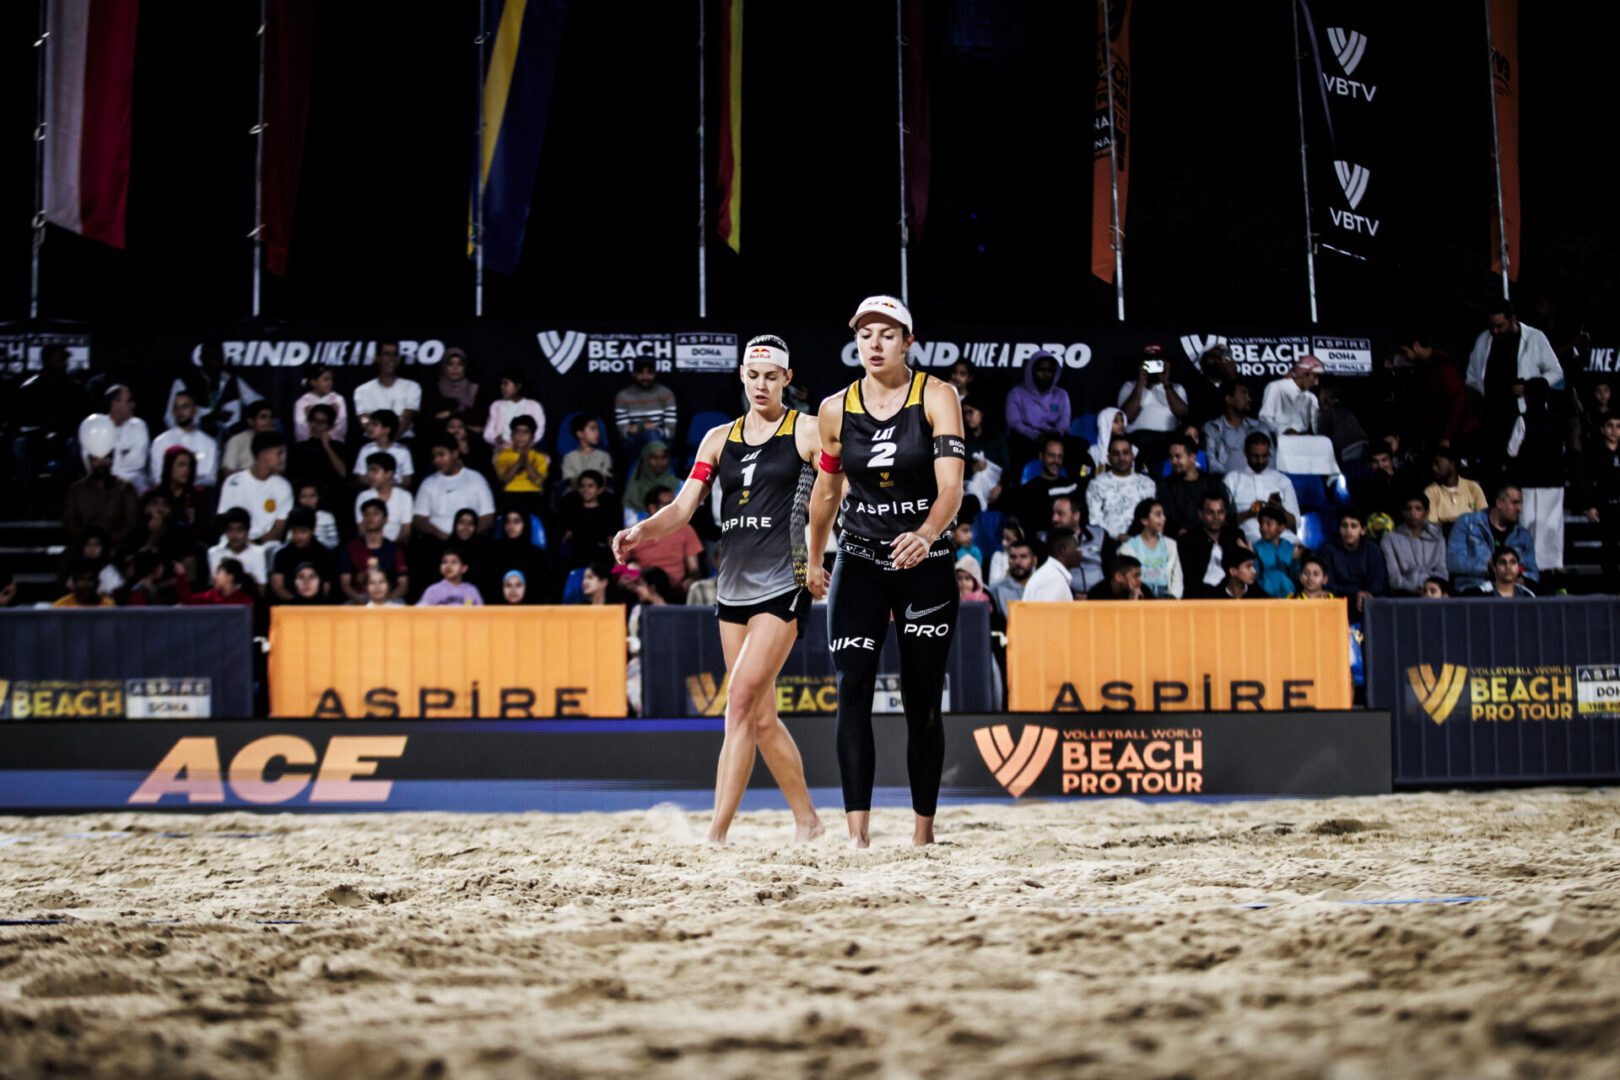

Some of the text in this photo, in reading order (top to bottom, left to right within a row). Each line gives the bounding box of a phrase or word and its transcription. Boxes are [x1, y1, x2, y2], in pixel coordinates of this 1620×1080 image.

[1322, 72, 1377, 102] VBTV
[1329, 206, 1380, 237] VBTV
[588, 341, 673, 359] BEACH
[680, 335, 734, 344] ASPIRE
[1317, 339, 1367, 349] ASPIRE
[192, 340, 310, 366] RIND
[311, 341, 350, 365] LIKE
[841, 341, 960, 367] GND
[963, 343, 999, 367] LIKE
[997, 343, 1010, 367] A
[1229, 344, 1310, 362] BEACH
[1583, 348, 1614, 372] IKE
[588, 360, 673, 373] PRO TR
[871, 425, 896, 441] LAT
[866, 441, 898, 468] 2
[741, 462, 758, 487] 1
[856, 498, 930, 516] ASPIRE
[721, 515, 773, 534] ASPIRE
[903, 623, 950, 638] PRO
[1580, 669, 1620, 681] ASP
[776, 685, 839, 712] EAC
[1470, 676, 1573, 702] BEACH
[12, 690, 122, 718] BEACH
[1472, 703, 1573, 720] PRO TOUR
[1062, 729, 1203, 740] VOLLEYBALL WORLD
[1062, 741, 1203, 771] BEACH
[127, 735, 408, 804] ACE
[1062, 772, 1203, 794] PRO TOUR
